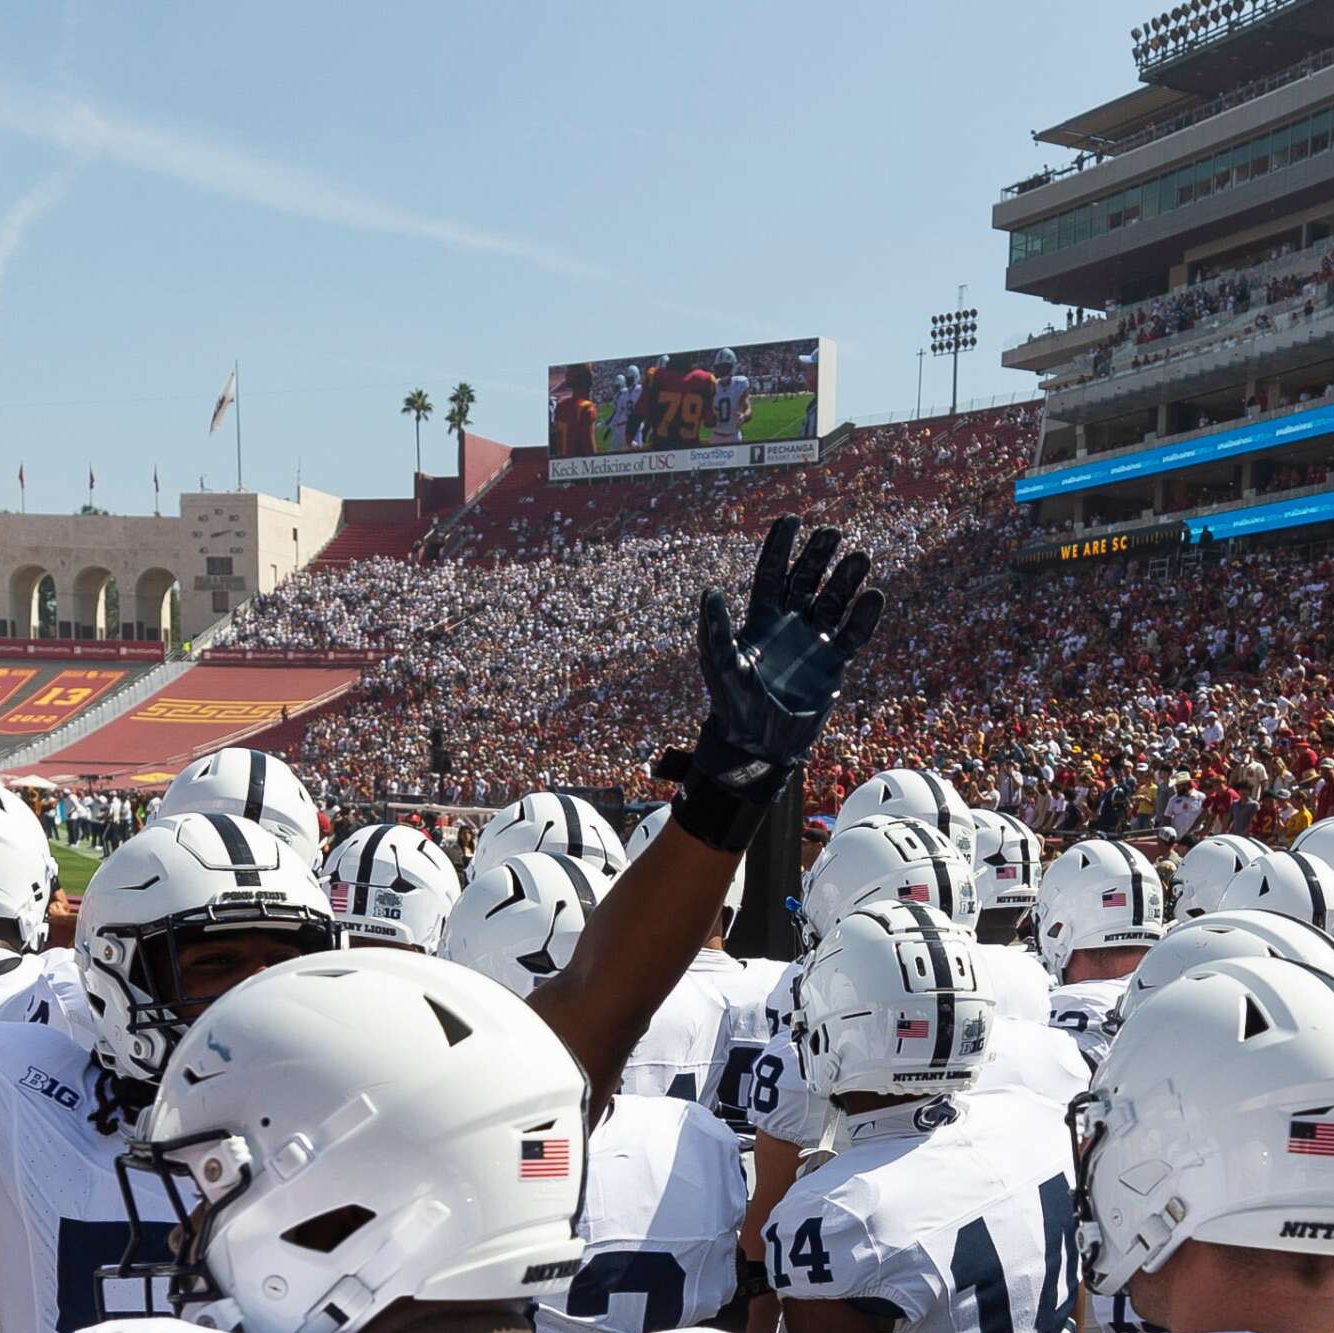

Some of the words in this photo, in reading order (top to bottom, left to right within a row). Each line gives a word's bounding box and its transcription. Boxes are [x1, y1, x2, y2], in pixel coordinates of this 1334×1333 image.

[691, 449, 735, 460] SmartStop
[768, 443, 814, 454] PECHANGA
[551, 461, 579, 477] Keck
[582, 458, 633, 475] Medicine
[634, 458, 646, 470] of
[648, 453, 676, 470] USC
[1061, 545, 1078, 560] WE
[1083, 541, 1107, 557] ARE
[1112, 535, 1128, 551] SC
[34, 687, 93, 705] 13
[222, 890, 255, 902] PENN
[256, 890, 287, 902] STATE
[364, 924, 397, 936] LIONS
[892, 1070, 945, 1082] NITTANY
[19, 1065, 82, 1111] B1G
[766, 1216, 834, 1289] 14
